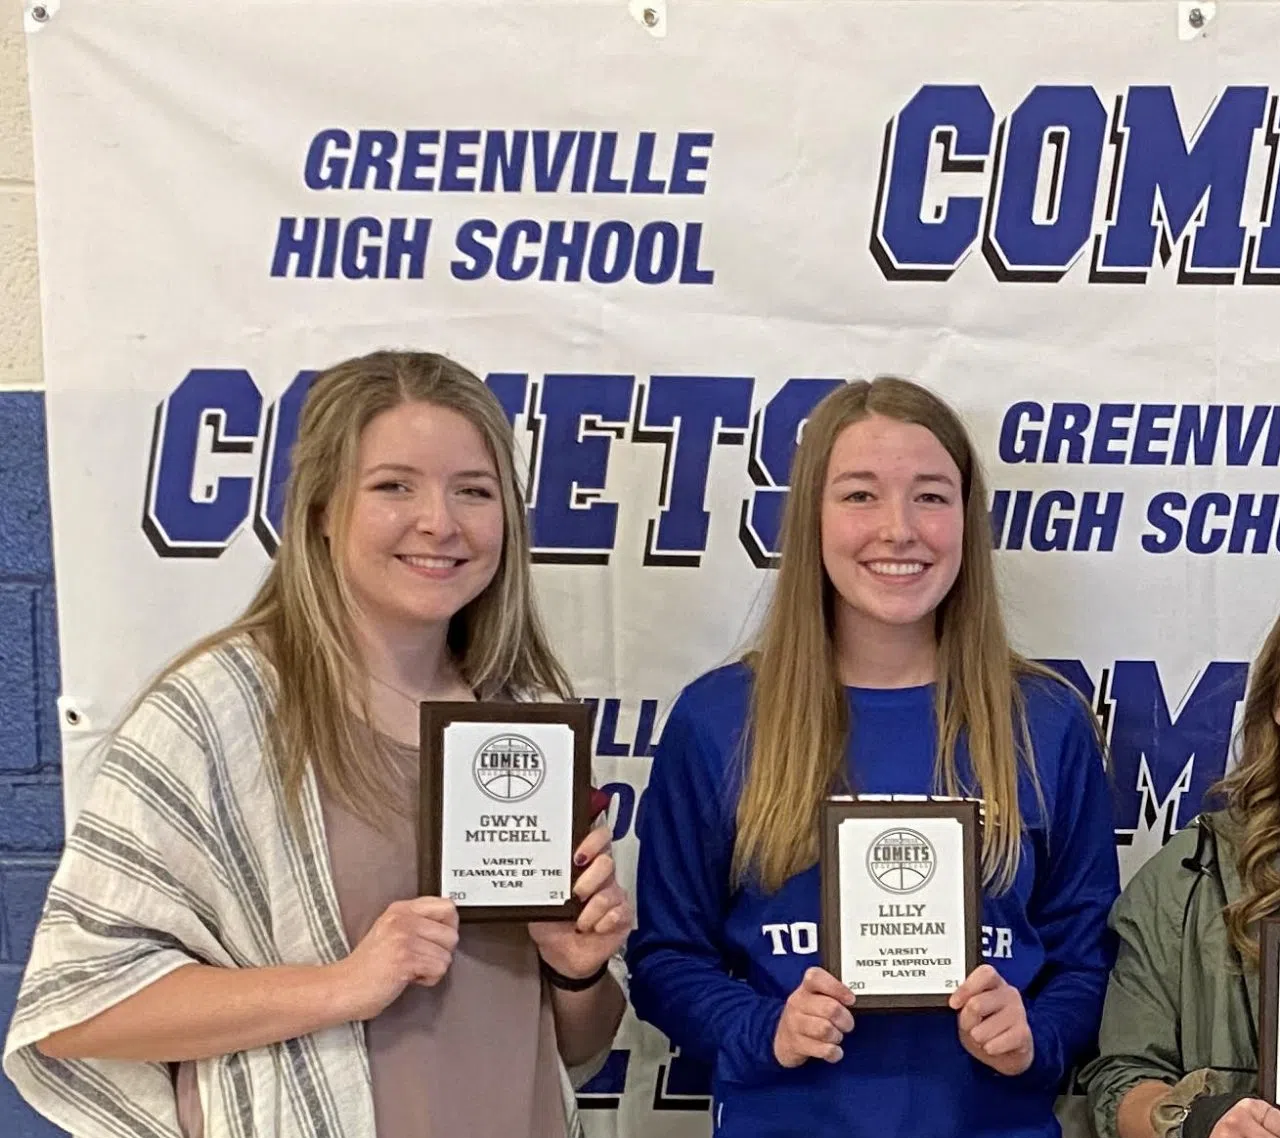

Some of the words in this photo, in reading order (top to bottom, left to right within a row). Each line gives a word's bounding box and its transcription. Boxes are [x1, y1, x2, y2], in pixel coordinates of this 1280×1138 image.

[304, 128, 714, 195] GREENVILLE
[270, 217, 432, 280] HIGH
[450, 219, 714, 285] SCHOOL
[481, 753, 539, 768] COMETS
[480, 815, 538, 828] GWYN
[465, 830, 550, 842] MITCHELL
[874, 846, 930, 861] COMETS
[452, 869, 518, 877] TEAMMATE
[522, 869, 538, 877] OF
[542, 869, 563, 877] THE
[491, 880, 523, 888] YEAR
[449, 892, 466, 900] 20
[549, 891, 564, 899] 21
[879, 904, 926, 917] LILLY
[860, 922, 946, 936] FUNNEMAN
[879, 948, 928, 956] VARSITY
[856, 958, 888, 967] MOST
[892, 958, 952, 966] IMPROVED
[882, 969, 926, 977] PLAYER
[849, 981, 865, 990] 20
[945, 980, 959, 988] 21
